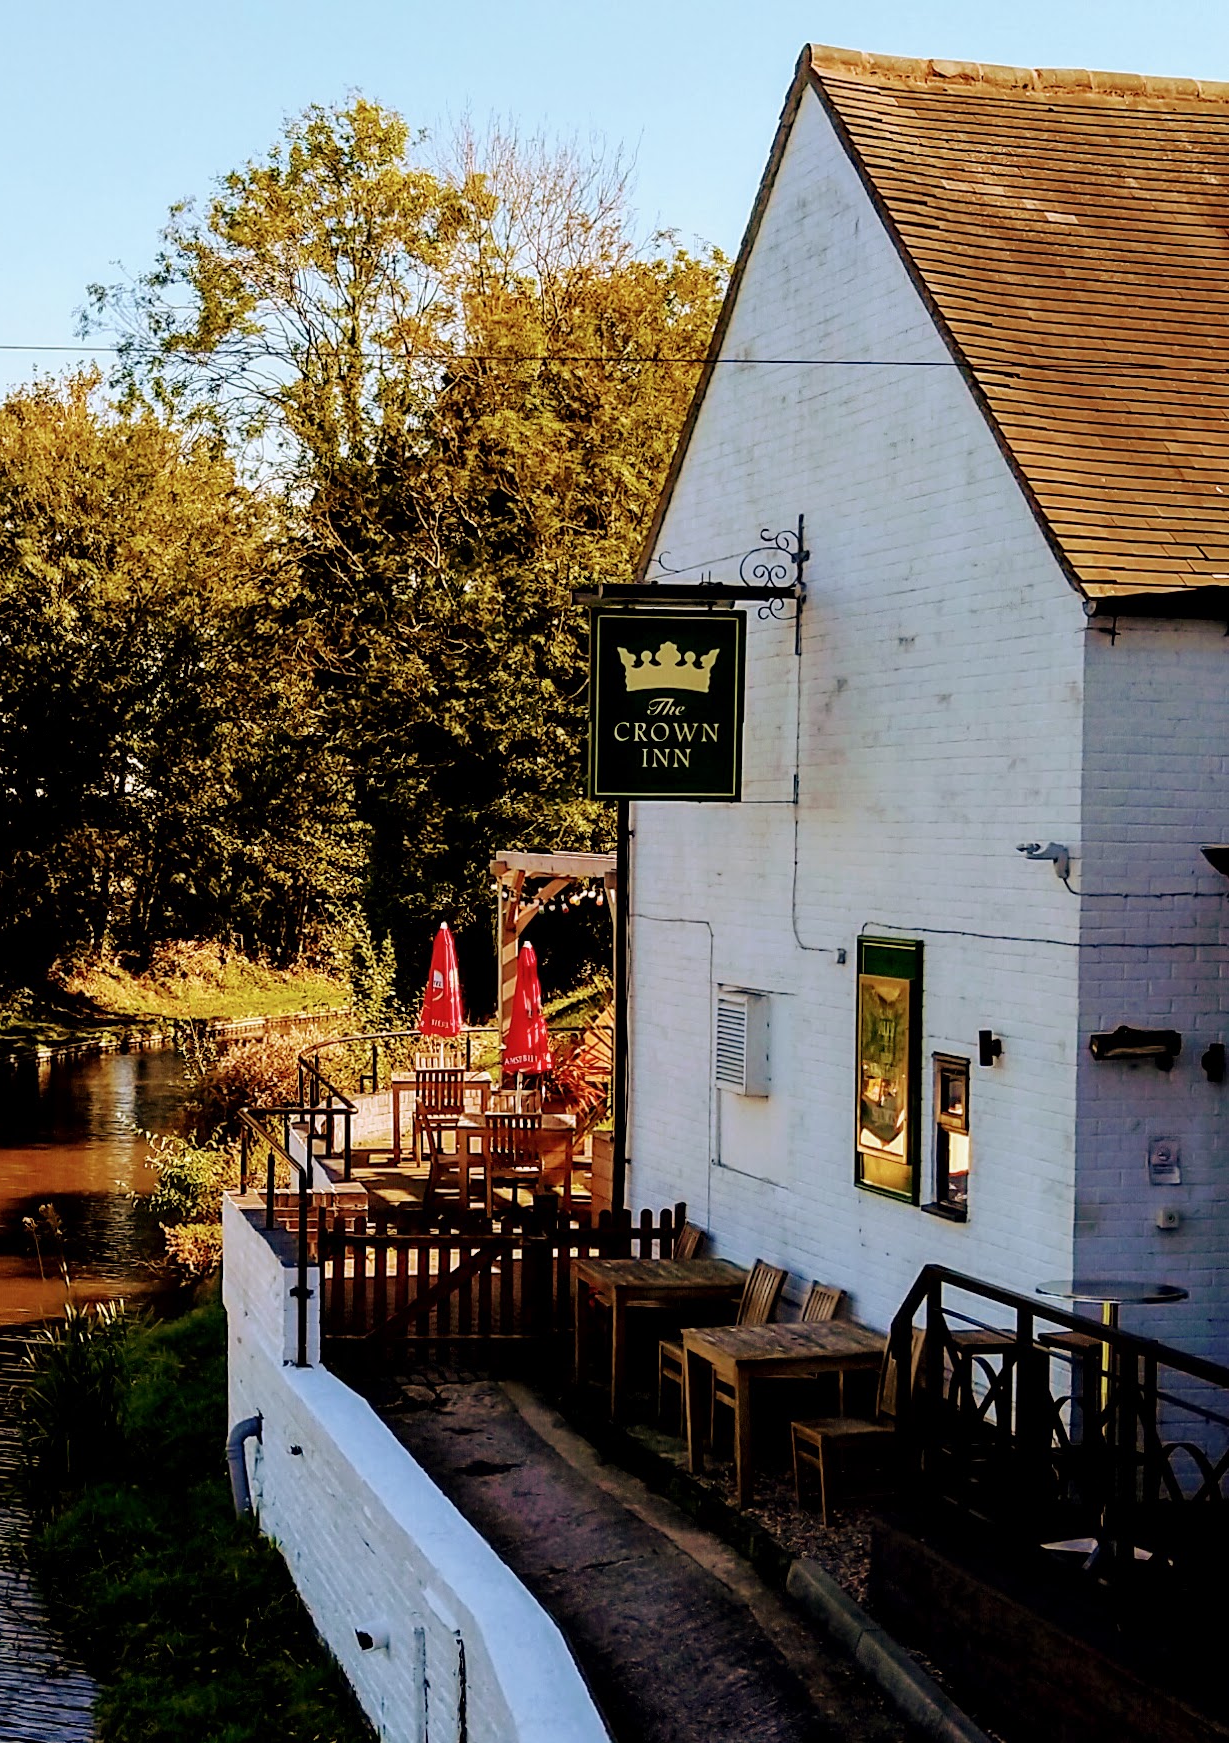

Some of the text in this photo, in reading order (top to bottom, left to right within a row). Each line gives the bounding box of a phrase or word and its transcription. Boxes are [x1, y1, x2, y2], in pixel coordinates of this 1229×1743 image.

[646, 697, 686, 716] The
[613, 722, 719, 742] CROWN
[641, 748, 692, 768] INN
